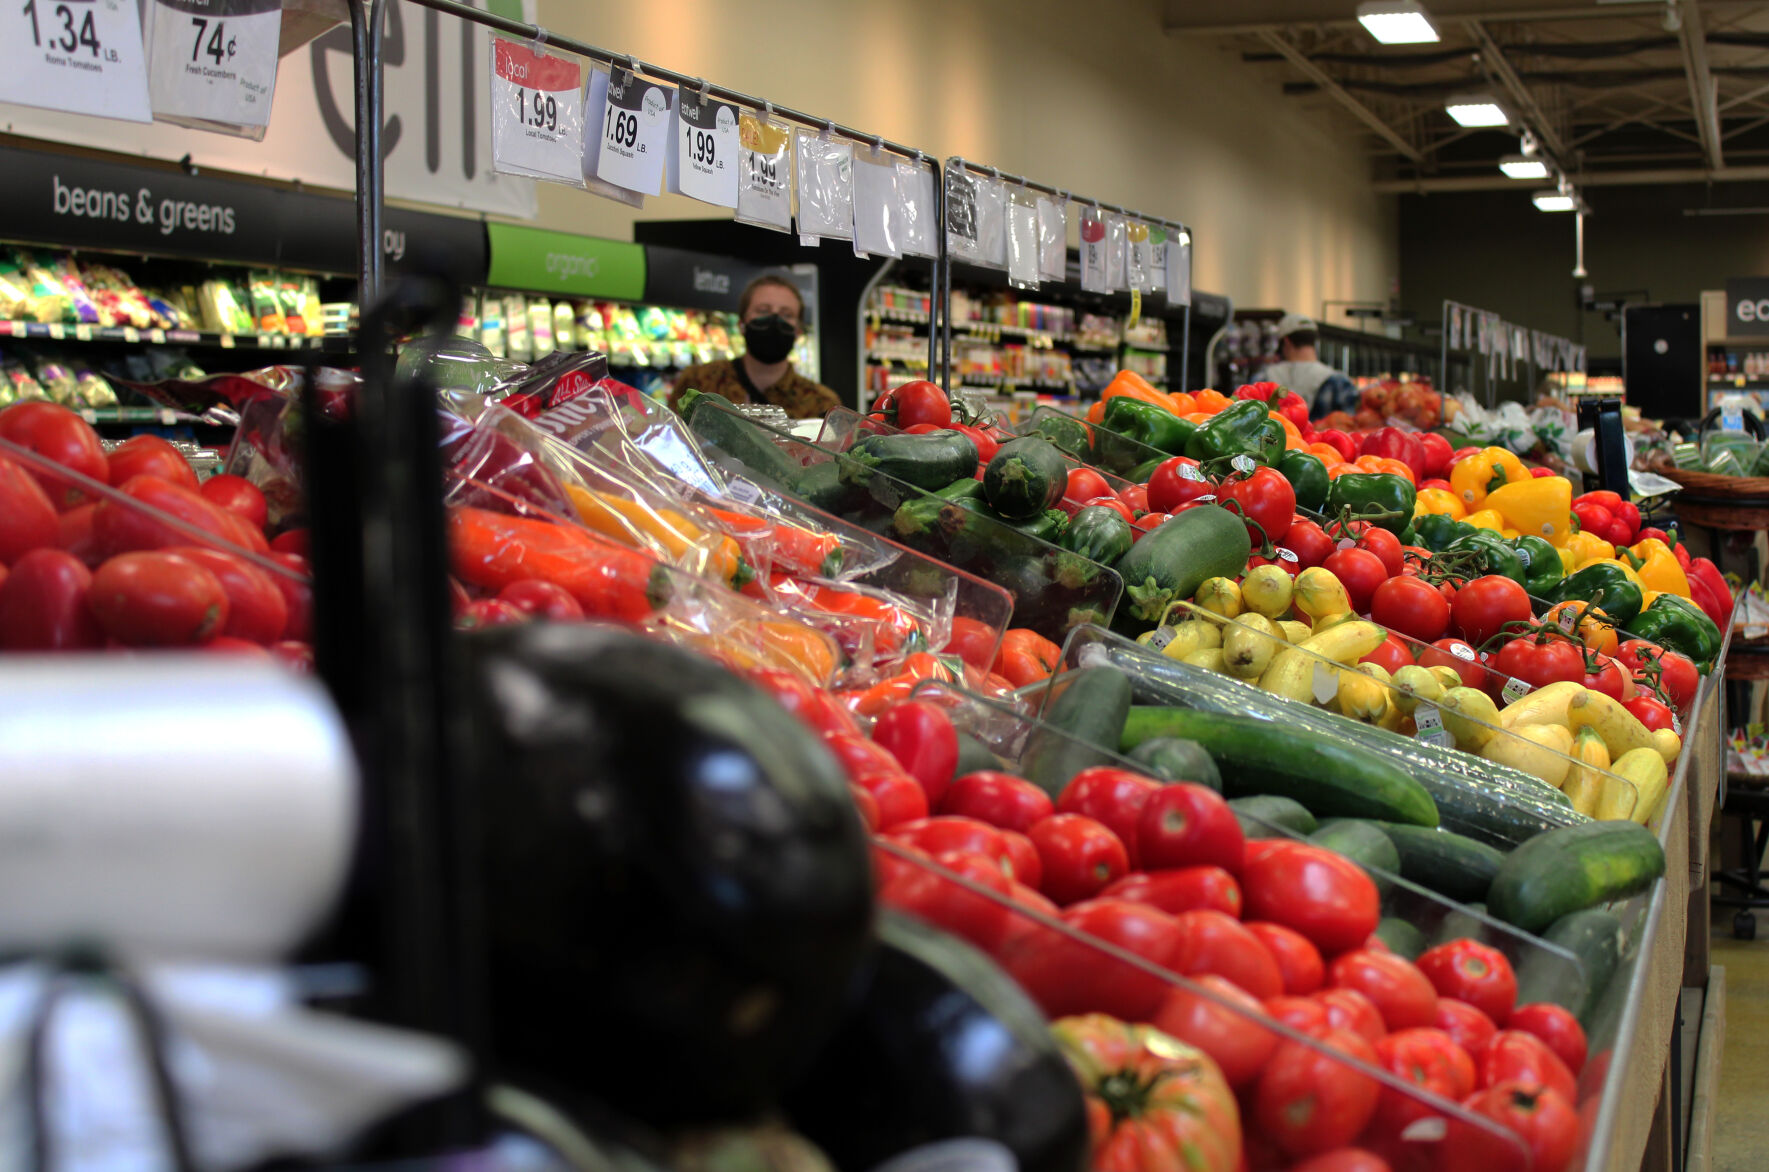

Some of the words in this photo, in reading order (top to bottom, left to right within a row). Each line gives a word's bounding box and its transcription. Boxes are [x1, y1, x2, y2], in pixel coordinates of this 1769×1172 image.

[23, 0, 101, 57] 1.34
[104, 48, 122, 64] LB.
[191, 17, 237, 66] 74¢
[45, 53, 66, 67] Roma
[67, 57, 103, 73] Tomatoes
[185, 63, 202, 75] Fresh
[203, 67, 237, 80] Cucumbers
[505, 57, 528, 79] local
[517, 87, 557, 132] 1.99
[606, 104, 638, 148] 1.69
[637, 142, 648, 153] LB.
[686, 126, 715, 165] 1.99
[716, 159, 725, 170] LB.
[53, 174, 130, 222] beans
[135, 187, 154, 224] &
[160, 199, 236, 235] greens
[384, 229, 406, 261] oy
[545, 251, 600, 281] organic
